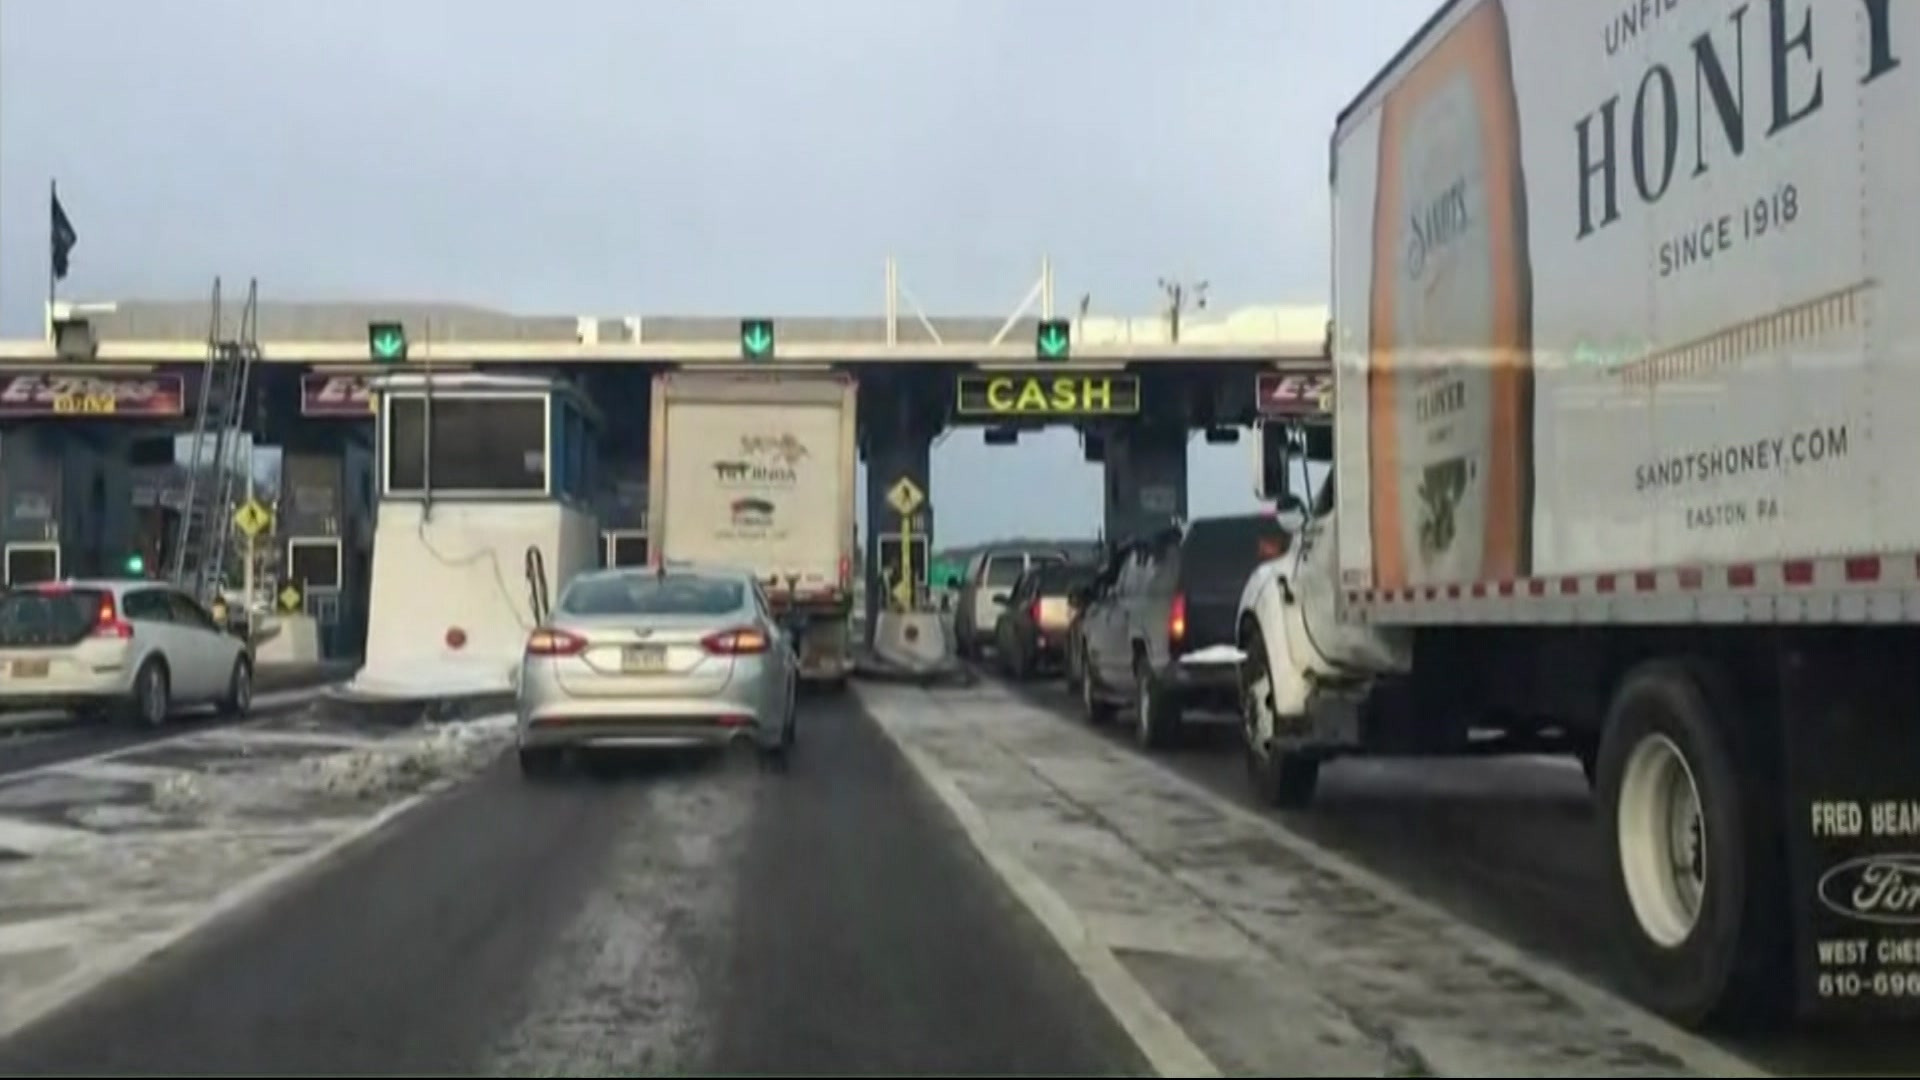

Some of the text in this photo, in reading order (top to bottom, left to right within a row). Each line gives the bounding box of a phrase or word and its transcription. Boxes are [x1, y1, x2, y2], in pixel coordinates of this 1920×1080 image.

[1659, 183, 1799, 277] SINCE 1918
[987, 376, 1111, 411] CASH
[1635, 425, 1848, 490] SANDTSHONEY.COM
[1811, 801, 1863, 836] FRED
[1818, 939, 1869, 964] WEST
